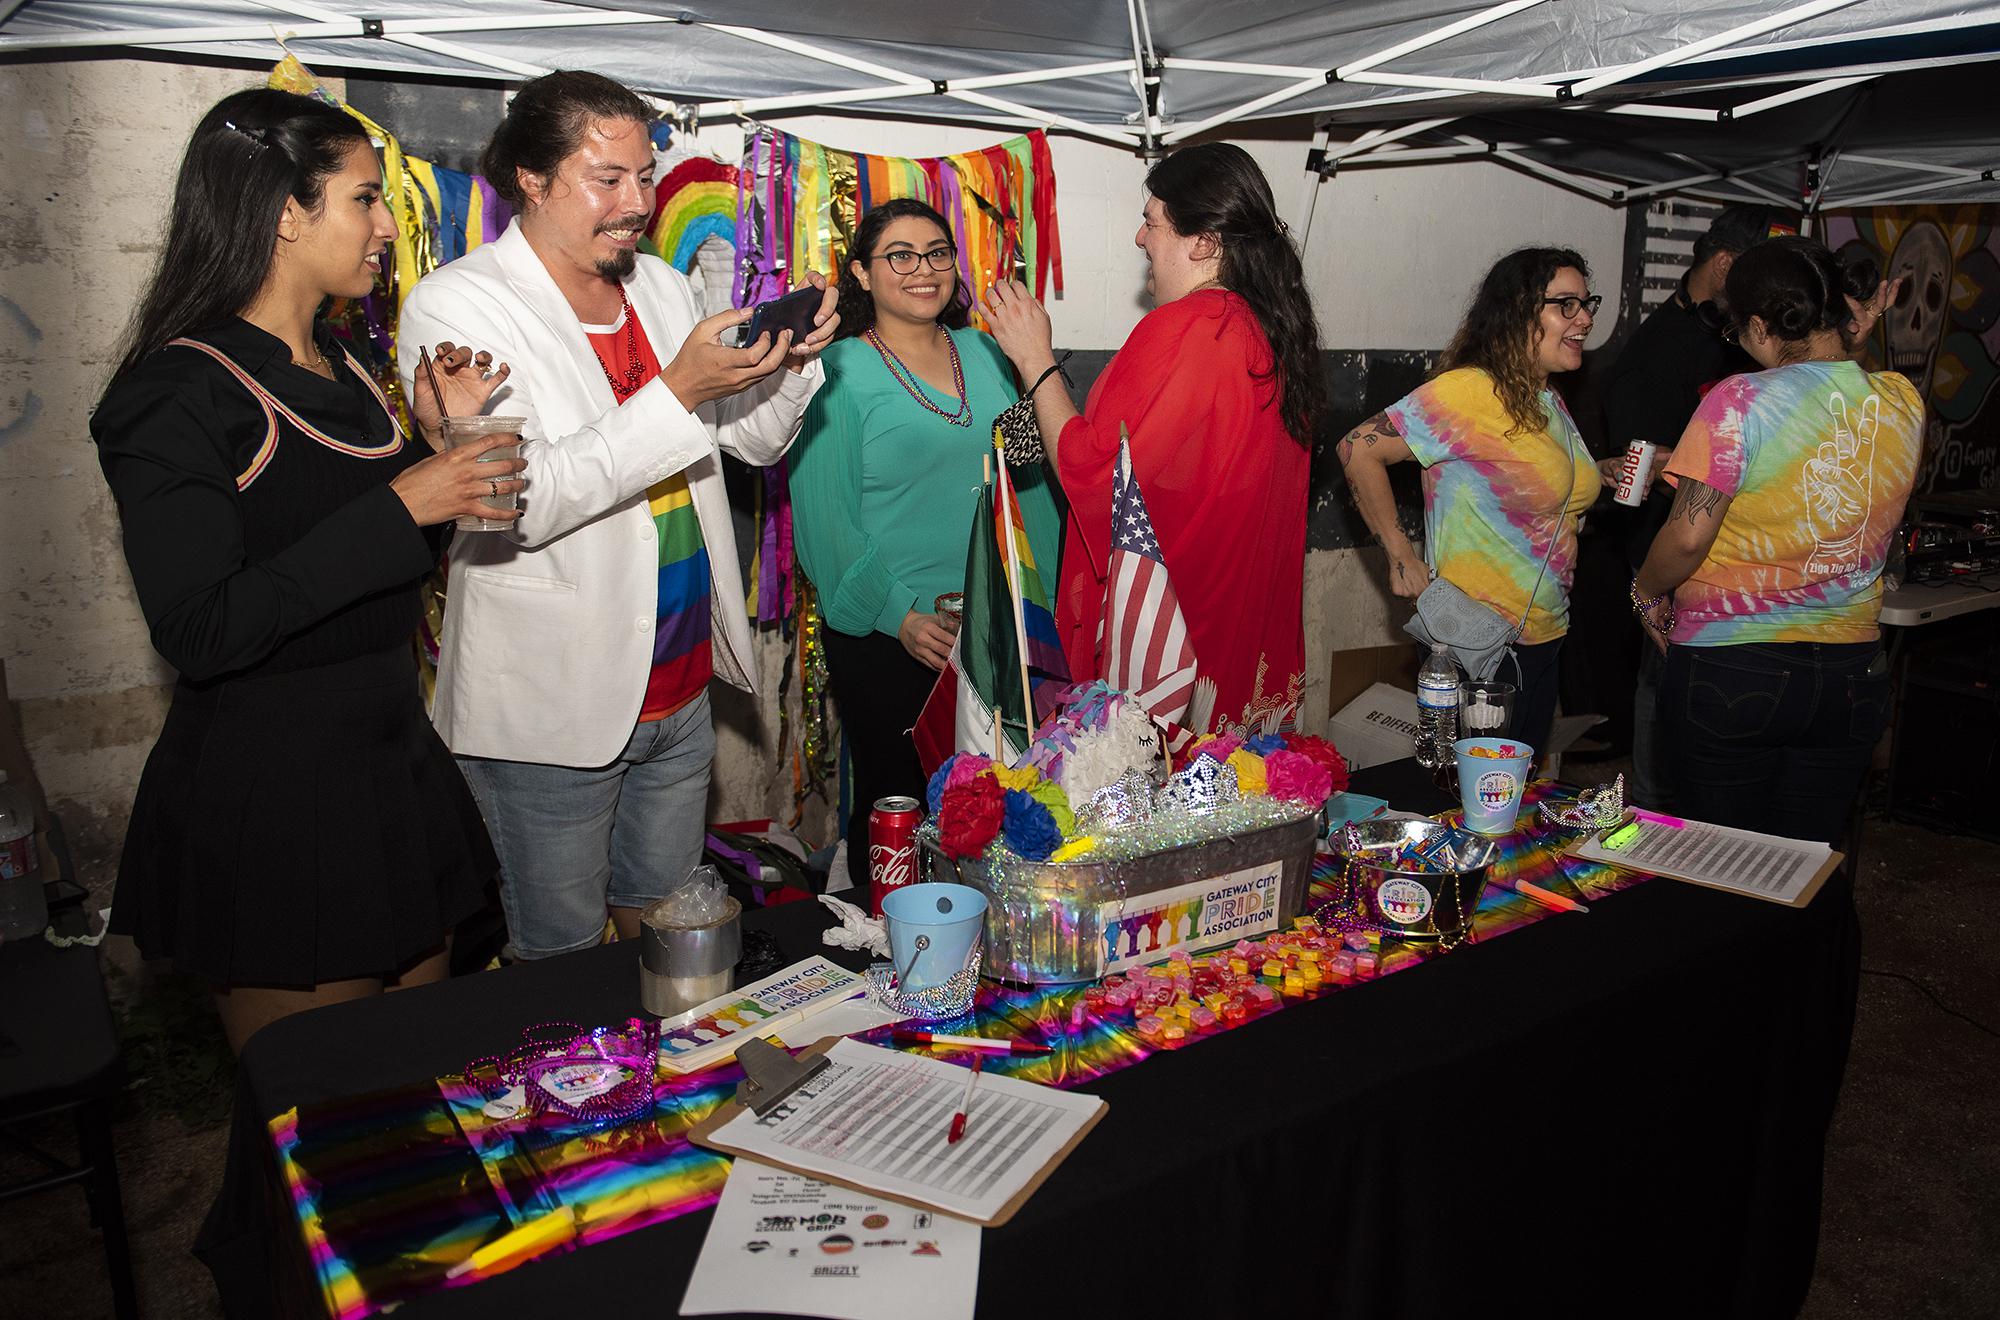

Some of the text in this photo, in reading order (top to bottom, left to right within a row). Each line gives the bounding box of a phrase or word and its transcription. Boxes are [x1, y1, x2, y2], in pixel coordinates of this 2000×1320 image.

[1620, 446, 1644, 486] BABE
[1809, 562, 1829, 575] Ziga
[1830, 562, 1843, 575] Zig
[1366, 710, 1384, 722] BE
[1206, 874, 1278, 902] GATEWAY CITY
[1385, 880, 1424, 891] GATEWAY CITY
[1204, 887, 1276, 925] PRIDE
[1203, 908, 1273, 937] ASSOCIATION
[750, 963, 828, 999] GATEWAY CITY
[761, 969, 847, 1008] PRIDE
[779, 976, 855, 1012] ASSOCIATION
[800, 1213, 847, 1226] MOB
[806, 1224, 837, 1232] GRIP
